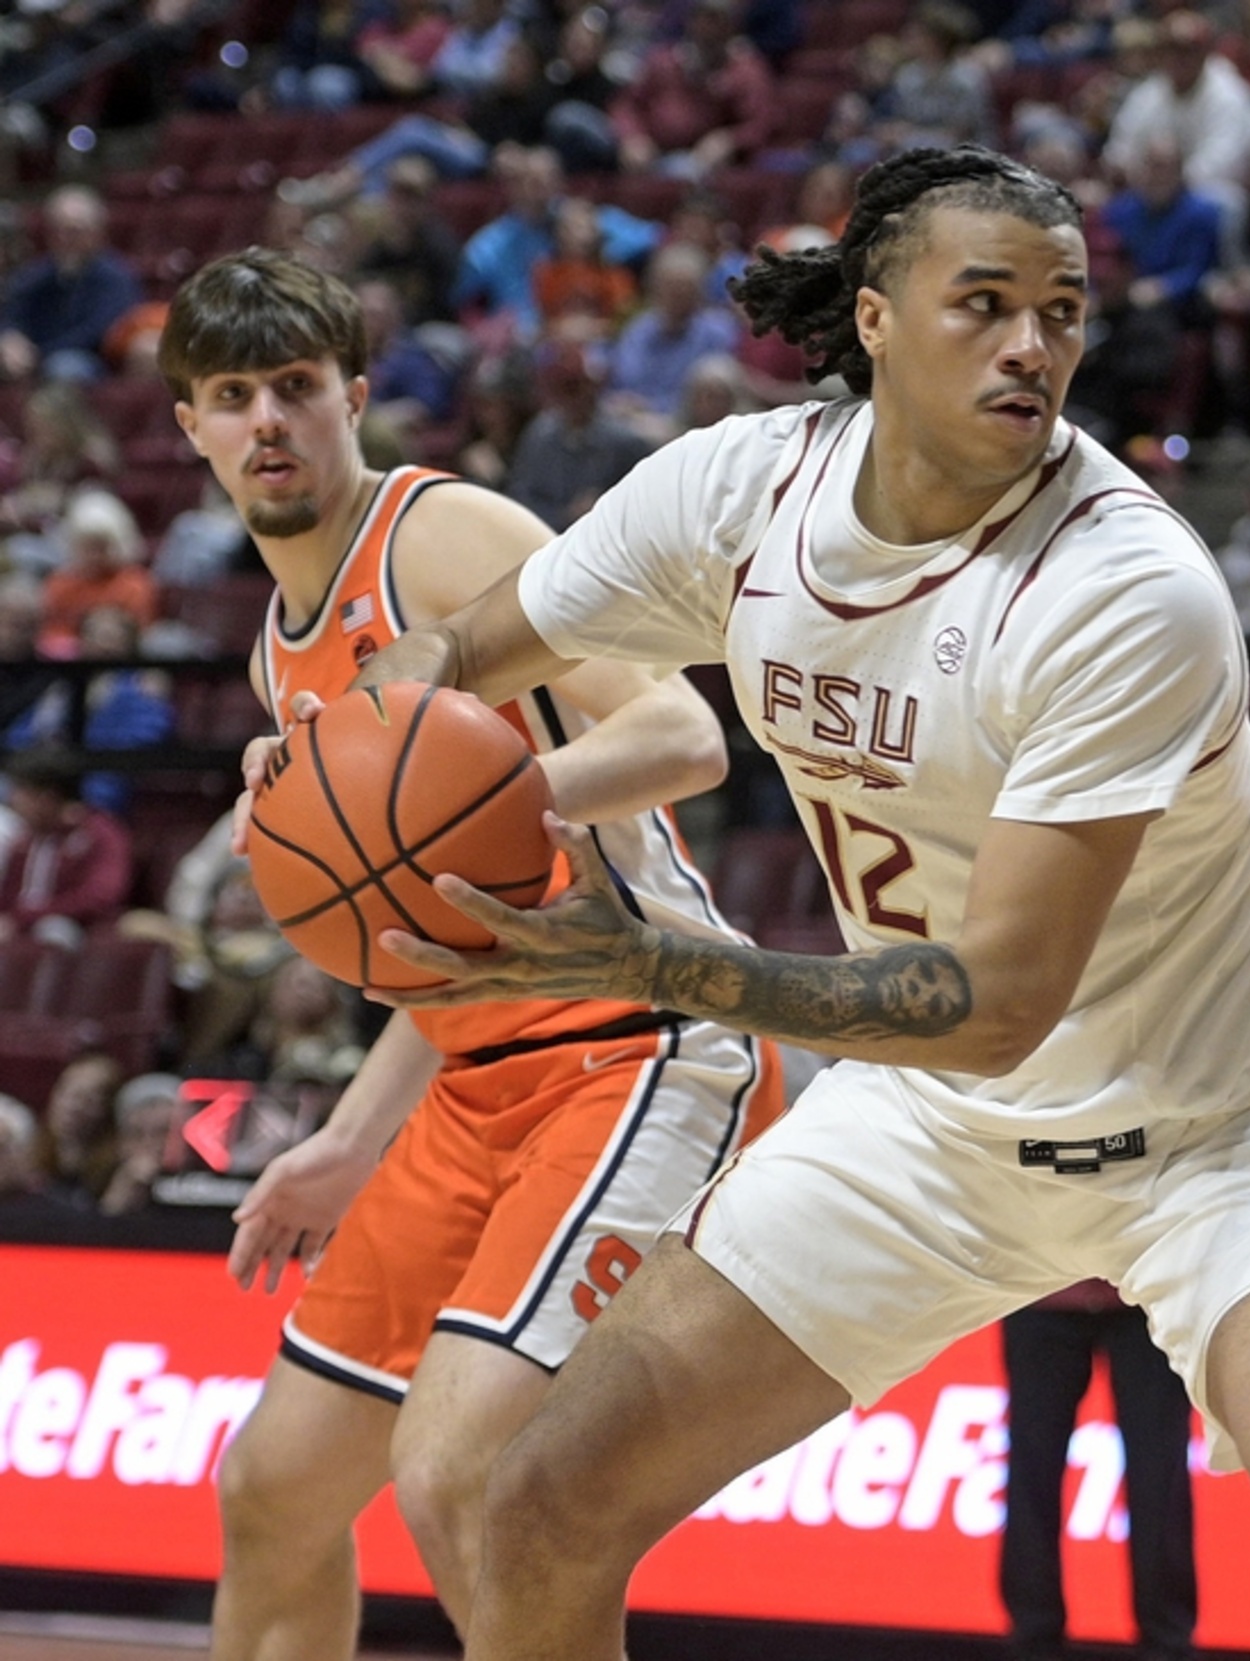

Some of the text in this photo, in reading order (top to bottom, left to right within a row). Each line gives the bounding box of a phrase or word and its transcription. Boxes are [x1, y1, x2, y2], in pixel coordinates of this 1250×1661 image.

[761, 659, 918, 764] FSU
[806, 797, 930, 940] 12
[1105, 1134, 1126, 1150] 50
